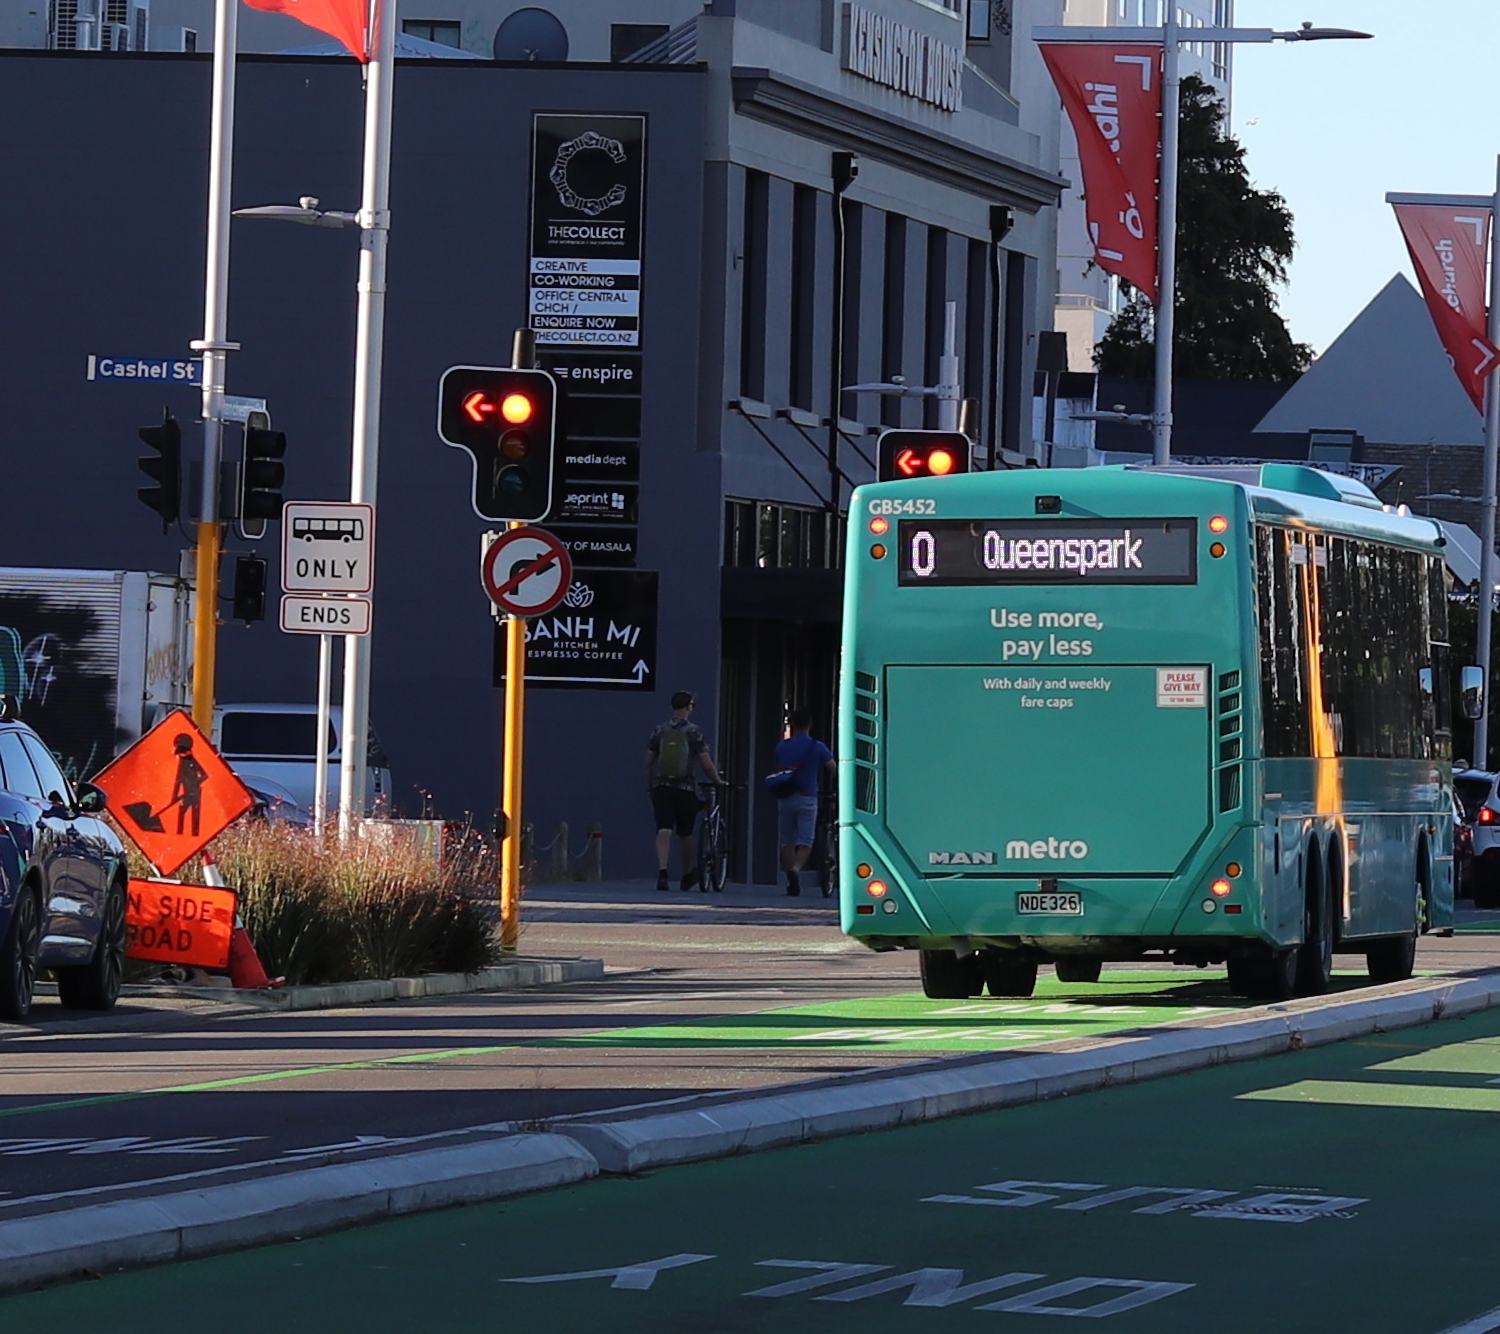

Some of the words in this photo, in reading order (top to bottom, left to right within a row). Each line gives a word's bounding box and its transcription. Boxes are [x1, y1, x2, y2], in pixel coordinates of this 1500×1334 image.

[849, 2, 925, 98] KENSINGTON
[925, 36, 964, 112] HOUSE
[548, 226, 625, 239] THECOLLECT
[535, 261, 588, 272] CREATIVE
[534, 275, 615, 286] CO-WORKING
[535, 291, 575, 301] OFFICE
[578, 292, 628, 302] CENTRAL
[535, 303, 568, 313] CHCH
[534, 317, 583, 328] ENQUIRE
[586, 318, 616, 328] NOW
[535, 332, 632, 342] THECOLLECT.CO.NZ
[100, 359, 168, 379] Cashel
[172, 362, 195, 380] St
[572, 364, 633, 383] enspire
[868, 499, 936, 515] GB5452
[574, 541, 588, 550] OF
[590, 542, 632, 552] MASALA
[982, 529, 1144, 576] Queenspark
[296, 558, 358, 578] ONLY
[300, 606, 351, 624] ENDS
[990, 609, 1032, 628] Use
[1038, 612, 1104, 630] more,
[606, 620, 641, 647] MI
[528, 650, 579, 658] ESPRESSO
[1002, 637, 1044, 659] pay
[1049, 634, 1093, 656] less
[983, 677, 1012, 690] With
[1014, 677, 1042, 692] daily
[1044, 677, 1068, 690] and
[1069, 677, 1111, 692] weekly
[1167, 673, 1196, 682] PLEASE
[1164, 683, 1182, 691] GIVE
[1184, 683, 1201, 691] WAY
[1020, 695, 1045, 708] fare
[1047, 697, 1074, 710] caps
[1005, 836, 1088, 859] metro
[929, 852, 994, 864] MAN
[128, 896, 142, 915] N
[159, 896, 213, 923] SIDE
[1020, 896, 1078, 911] NDE326
[127, 924, 193, 952] ROAD
[786, 1029, 1071, 1041] BUS
[920, 1180, 1368, 1223] BUS
[501, 1251, 1196, 1318] ONLY
